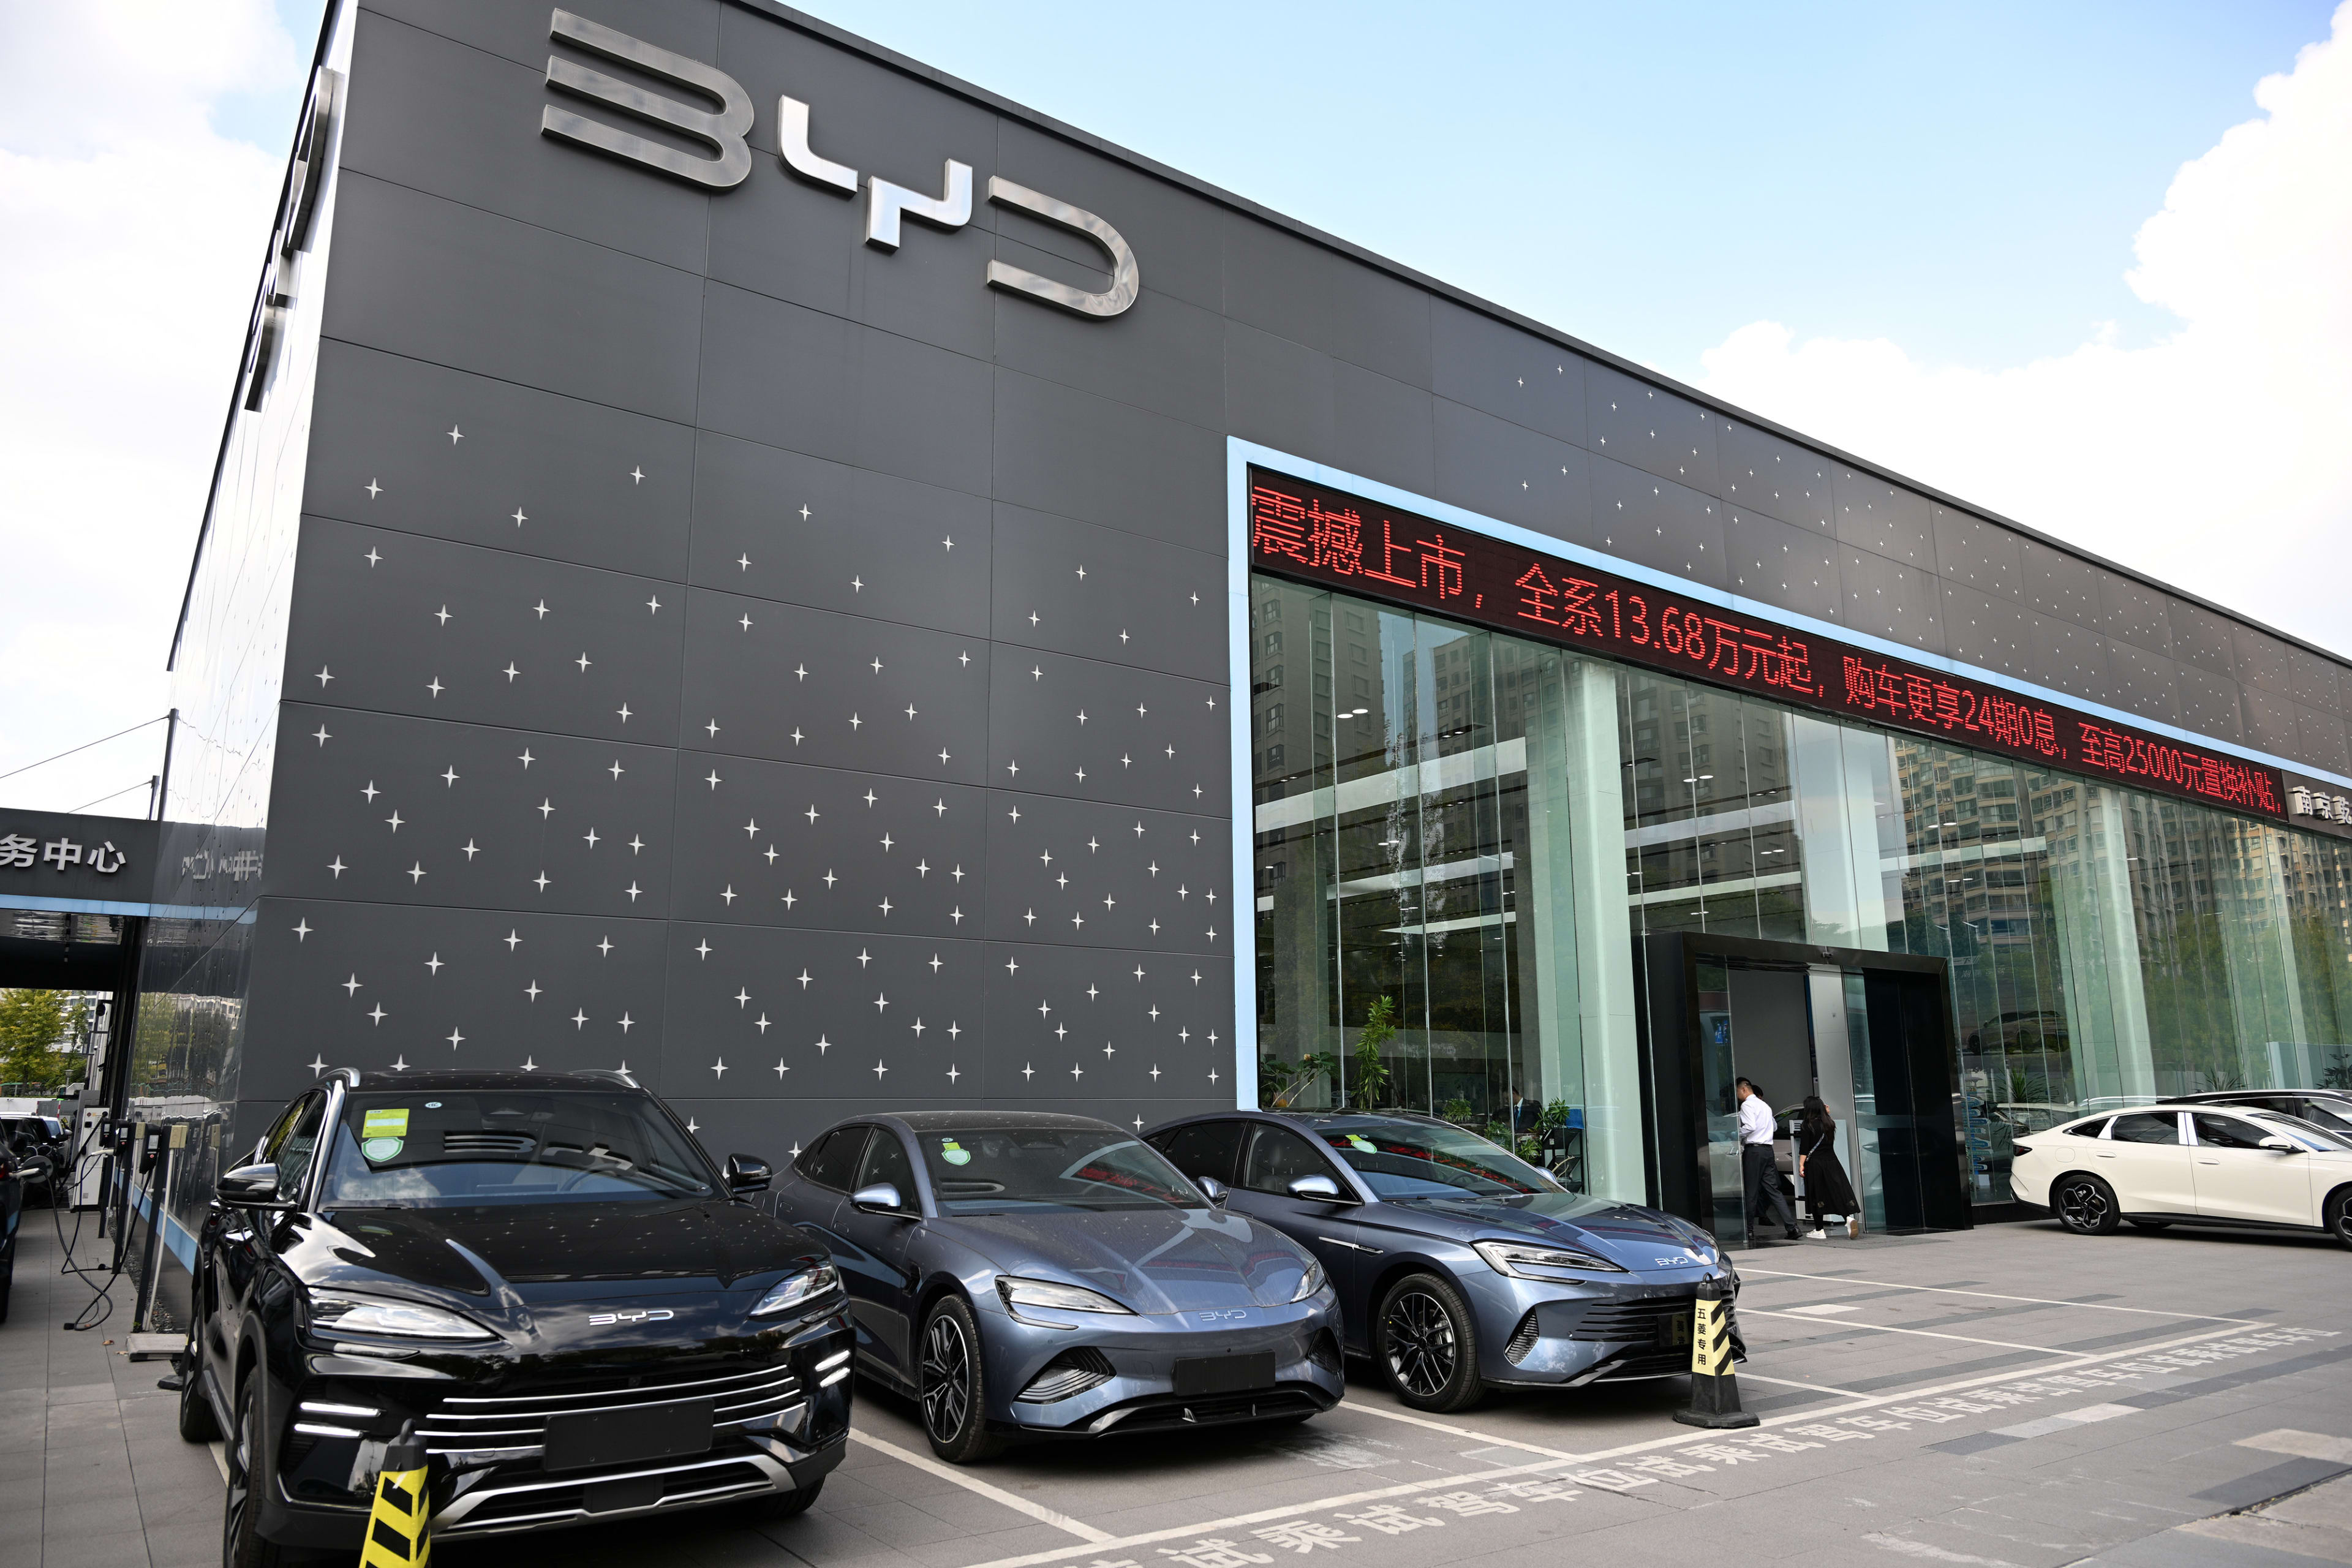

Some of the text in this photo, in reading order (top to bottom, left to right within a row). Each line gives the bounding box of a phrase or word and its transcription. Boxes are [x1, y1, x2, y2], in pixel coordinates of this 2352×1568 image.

[541, 7, 1139, 319] BYD
[0, 834, 126, 873] 务中心
[1655, 1256, 1688, 1267] BYD
[589, 1310, 674, 1326] BYD
[1199, 1310, 1247, 1322] BYD
[1697, 1308, 1706, 1365] 五菱专用
